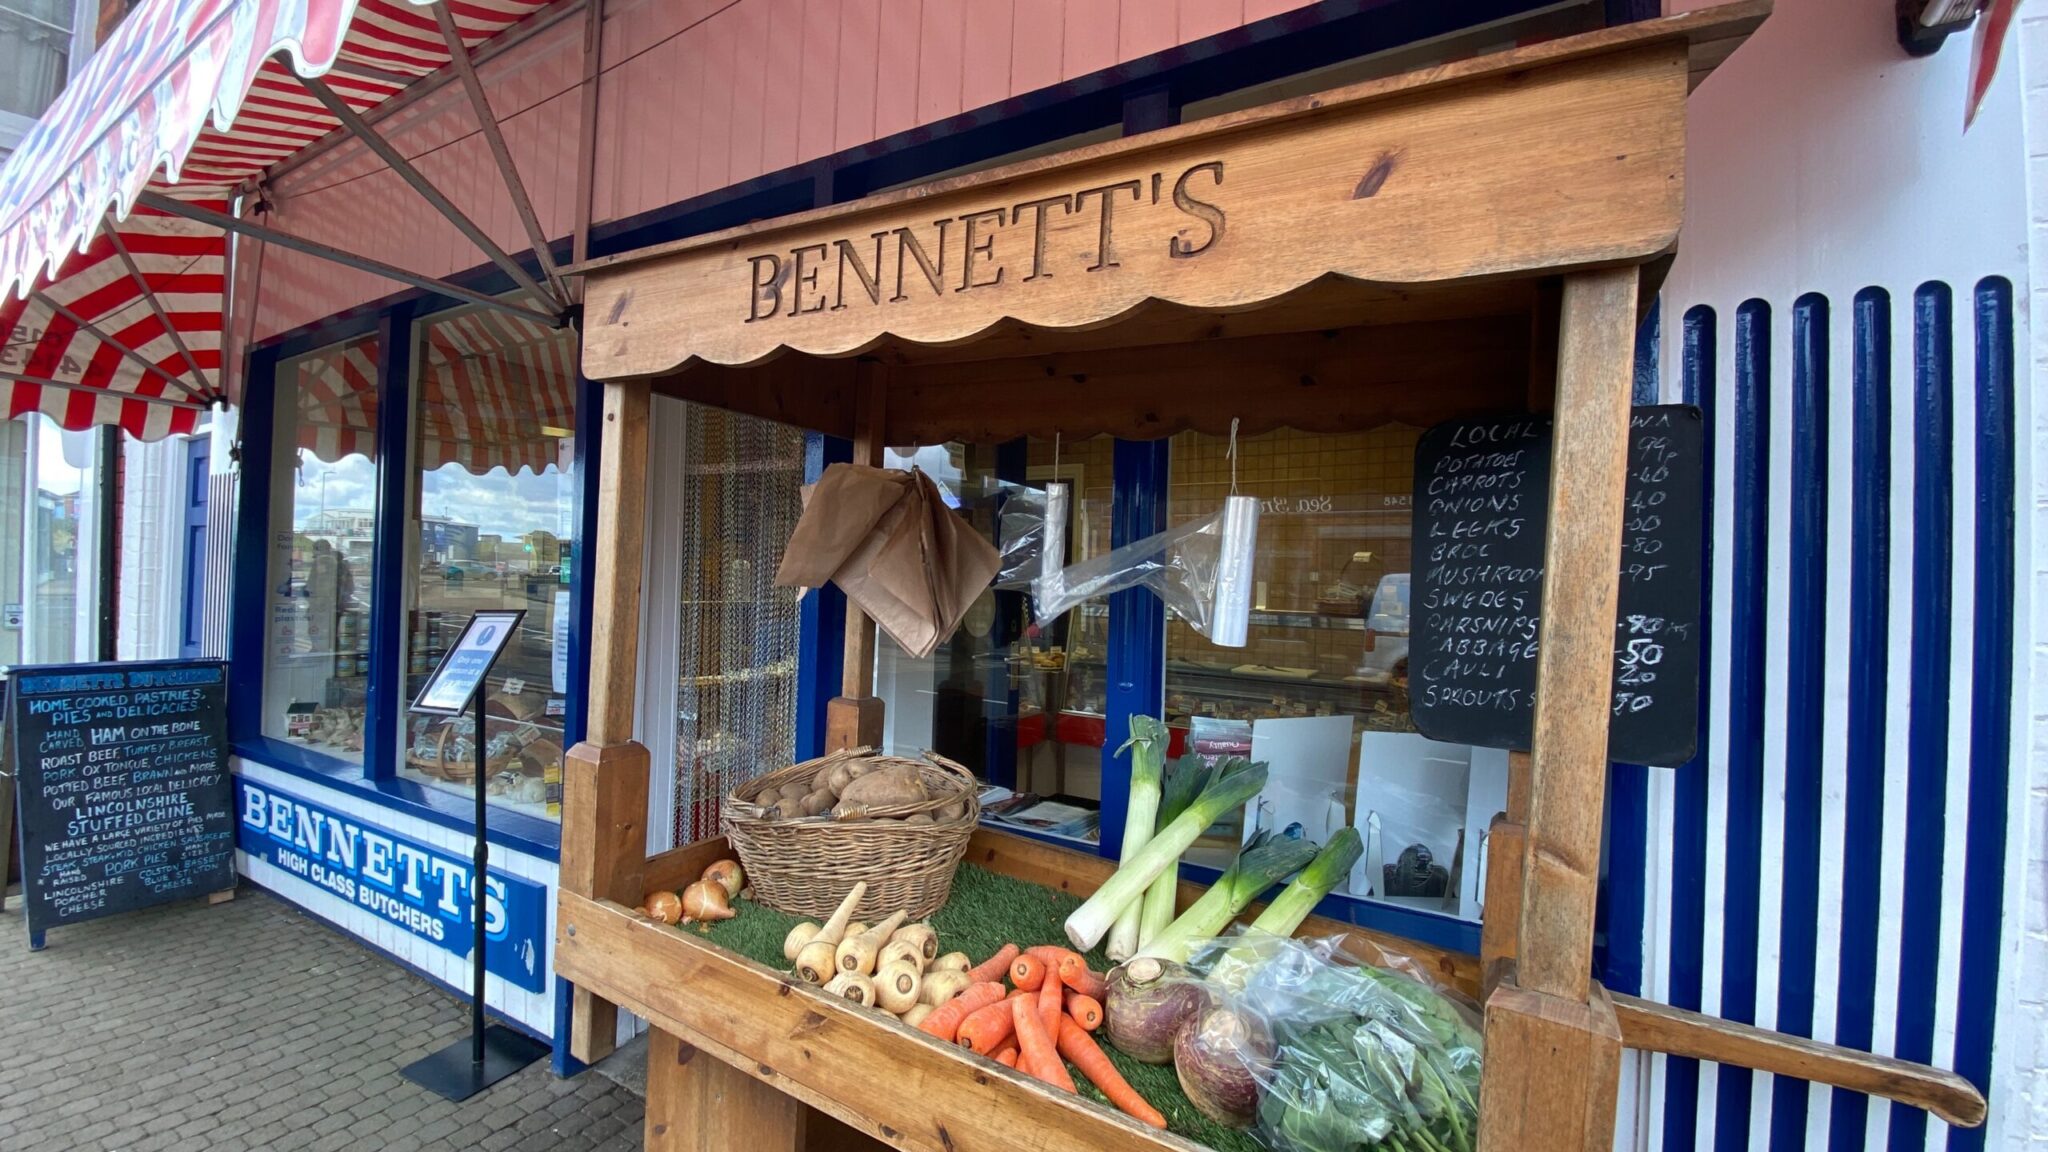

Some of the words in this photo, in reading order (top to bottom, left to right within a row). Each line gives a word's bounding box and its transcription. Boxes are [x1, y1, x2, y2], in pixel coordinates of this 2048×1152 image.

[744, 160, 1226, 324] BENNETT'S
[1450, 422, 1538, 448] LOCAL
[1434, 450, 1525, 473] POTATOES
[1428, 470, 1526, 495] CARROTS
[1428, 494, 1524, 514] ONIONS
[1430, 518, 1525, 539] LEEKS
[1431, 542, 1491, 561] BROC
[1424, 588, 1528, 611] SWEDES
[1425, 613, 1540, 640] PARSNIPS
[1434, 636, 1540, 662] ABBAGE
[1422, 659, 1505, 680] CAULI
[30, 699, 73, 715] HOME
[75, 695, 128, 709] COOKED
[1422, 685, 1521, 710] SPROUTS
[52, 709, 92, 725] PIES
[117, 701, 198, 718] DELICACIES
[46, 729, 80, 741] HAND
[91, 726, 126, 745] HAM
[131, 727, 149, 739] ON
[150, 725, 169, 736] THE
[172, 721, 201, 733] BONE
[41, 752, 83, 770] ROAST
[124, 743, 165, 757] TURKEY
[43, 781, 89, 797] POTTED
[133, 767, 173, 784] BRAWN
[82, 765, 101, 777] OX
[52, 797, 75, 810] OUR
[85, 788, 133, 804] FAMOUS
[136, 783, 166, 796] LOCAL
[168, 774, 221, 792] DELICACY
[76, 792, 188, 820] LINCOLNSHIRE
[67, 813, 143, 836] STUFFED
[146, 803, 195, 822] CHINE
[45, 842, 60, 852] WE
[62, 837, 88, 848] HAVE
[92, 834, 99, 843] A
[102, 829, 130, 840] LARGE
[134, 822, 171, 836] VARIETY
[172, 819, 183, 828] OF
[137, 840, 177, 855] CHICKEN
[45, 847, 93, 864] LOCALLY
[96, 839, 137, 853] SOURCED
[180, 849, 210, 860] SIZES
[242, 784, 508, 936] BENNETTS
[104, 858, 139, 877] PORK
[144, 852, 168, 866] PIES
[139, 863, 180, 880] COLSTON
[184, 851, 229, 869] BASSETT
[44, 876, 124, 900] LINCOLNSHIRE
[54, 889, 107, 908] POACHER
[144, 875, 169, 886] BLUE
[176, 864, 219, 878] STILTON
[59, 898, 106, 917] CHEESE
[154, 878, 193, 893] CHEESE
[278, 847, 308, 877] HIGH
[311, 862, 356, 899] CLASS
[359, 884, 445, 942] BUTCHERS
